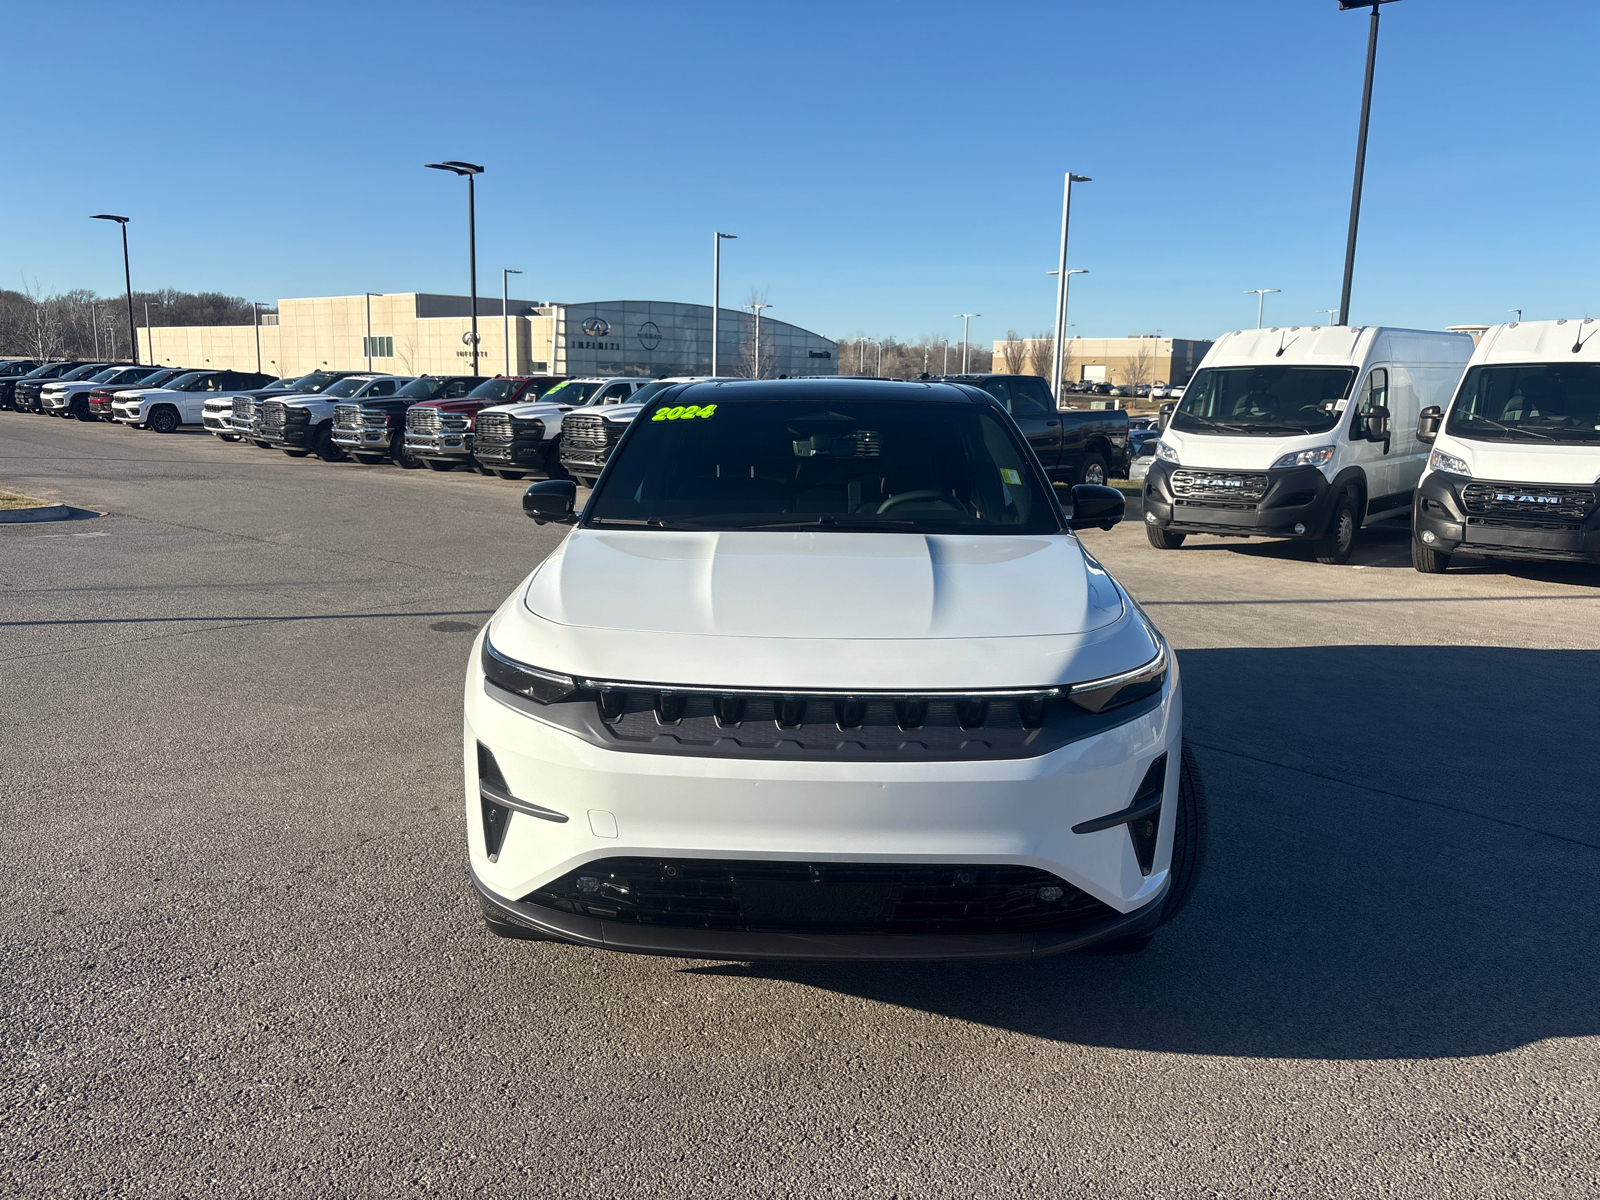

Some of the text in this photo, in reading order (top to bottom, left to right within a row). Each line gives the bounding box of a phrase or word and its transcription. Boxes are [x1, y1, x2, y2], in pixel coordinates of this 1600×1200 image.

[571, 341, 620, 351] INFINITI
[456, 350, 488, 358] INFIITI
[651, 404, 718, 422] 2024
[1195, 479, 1240, 487] RAM
[1496, 494, 1558, 504] RAM
